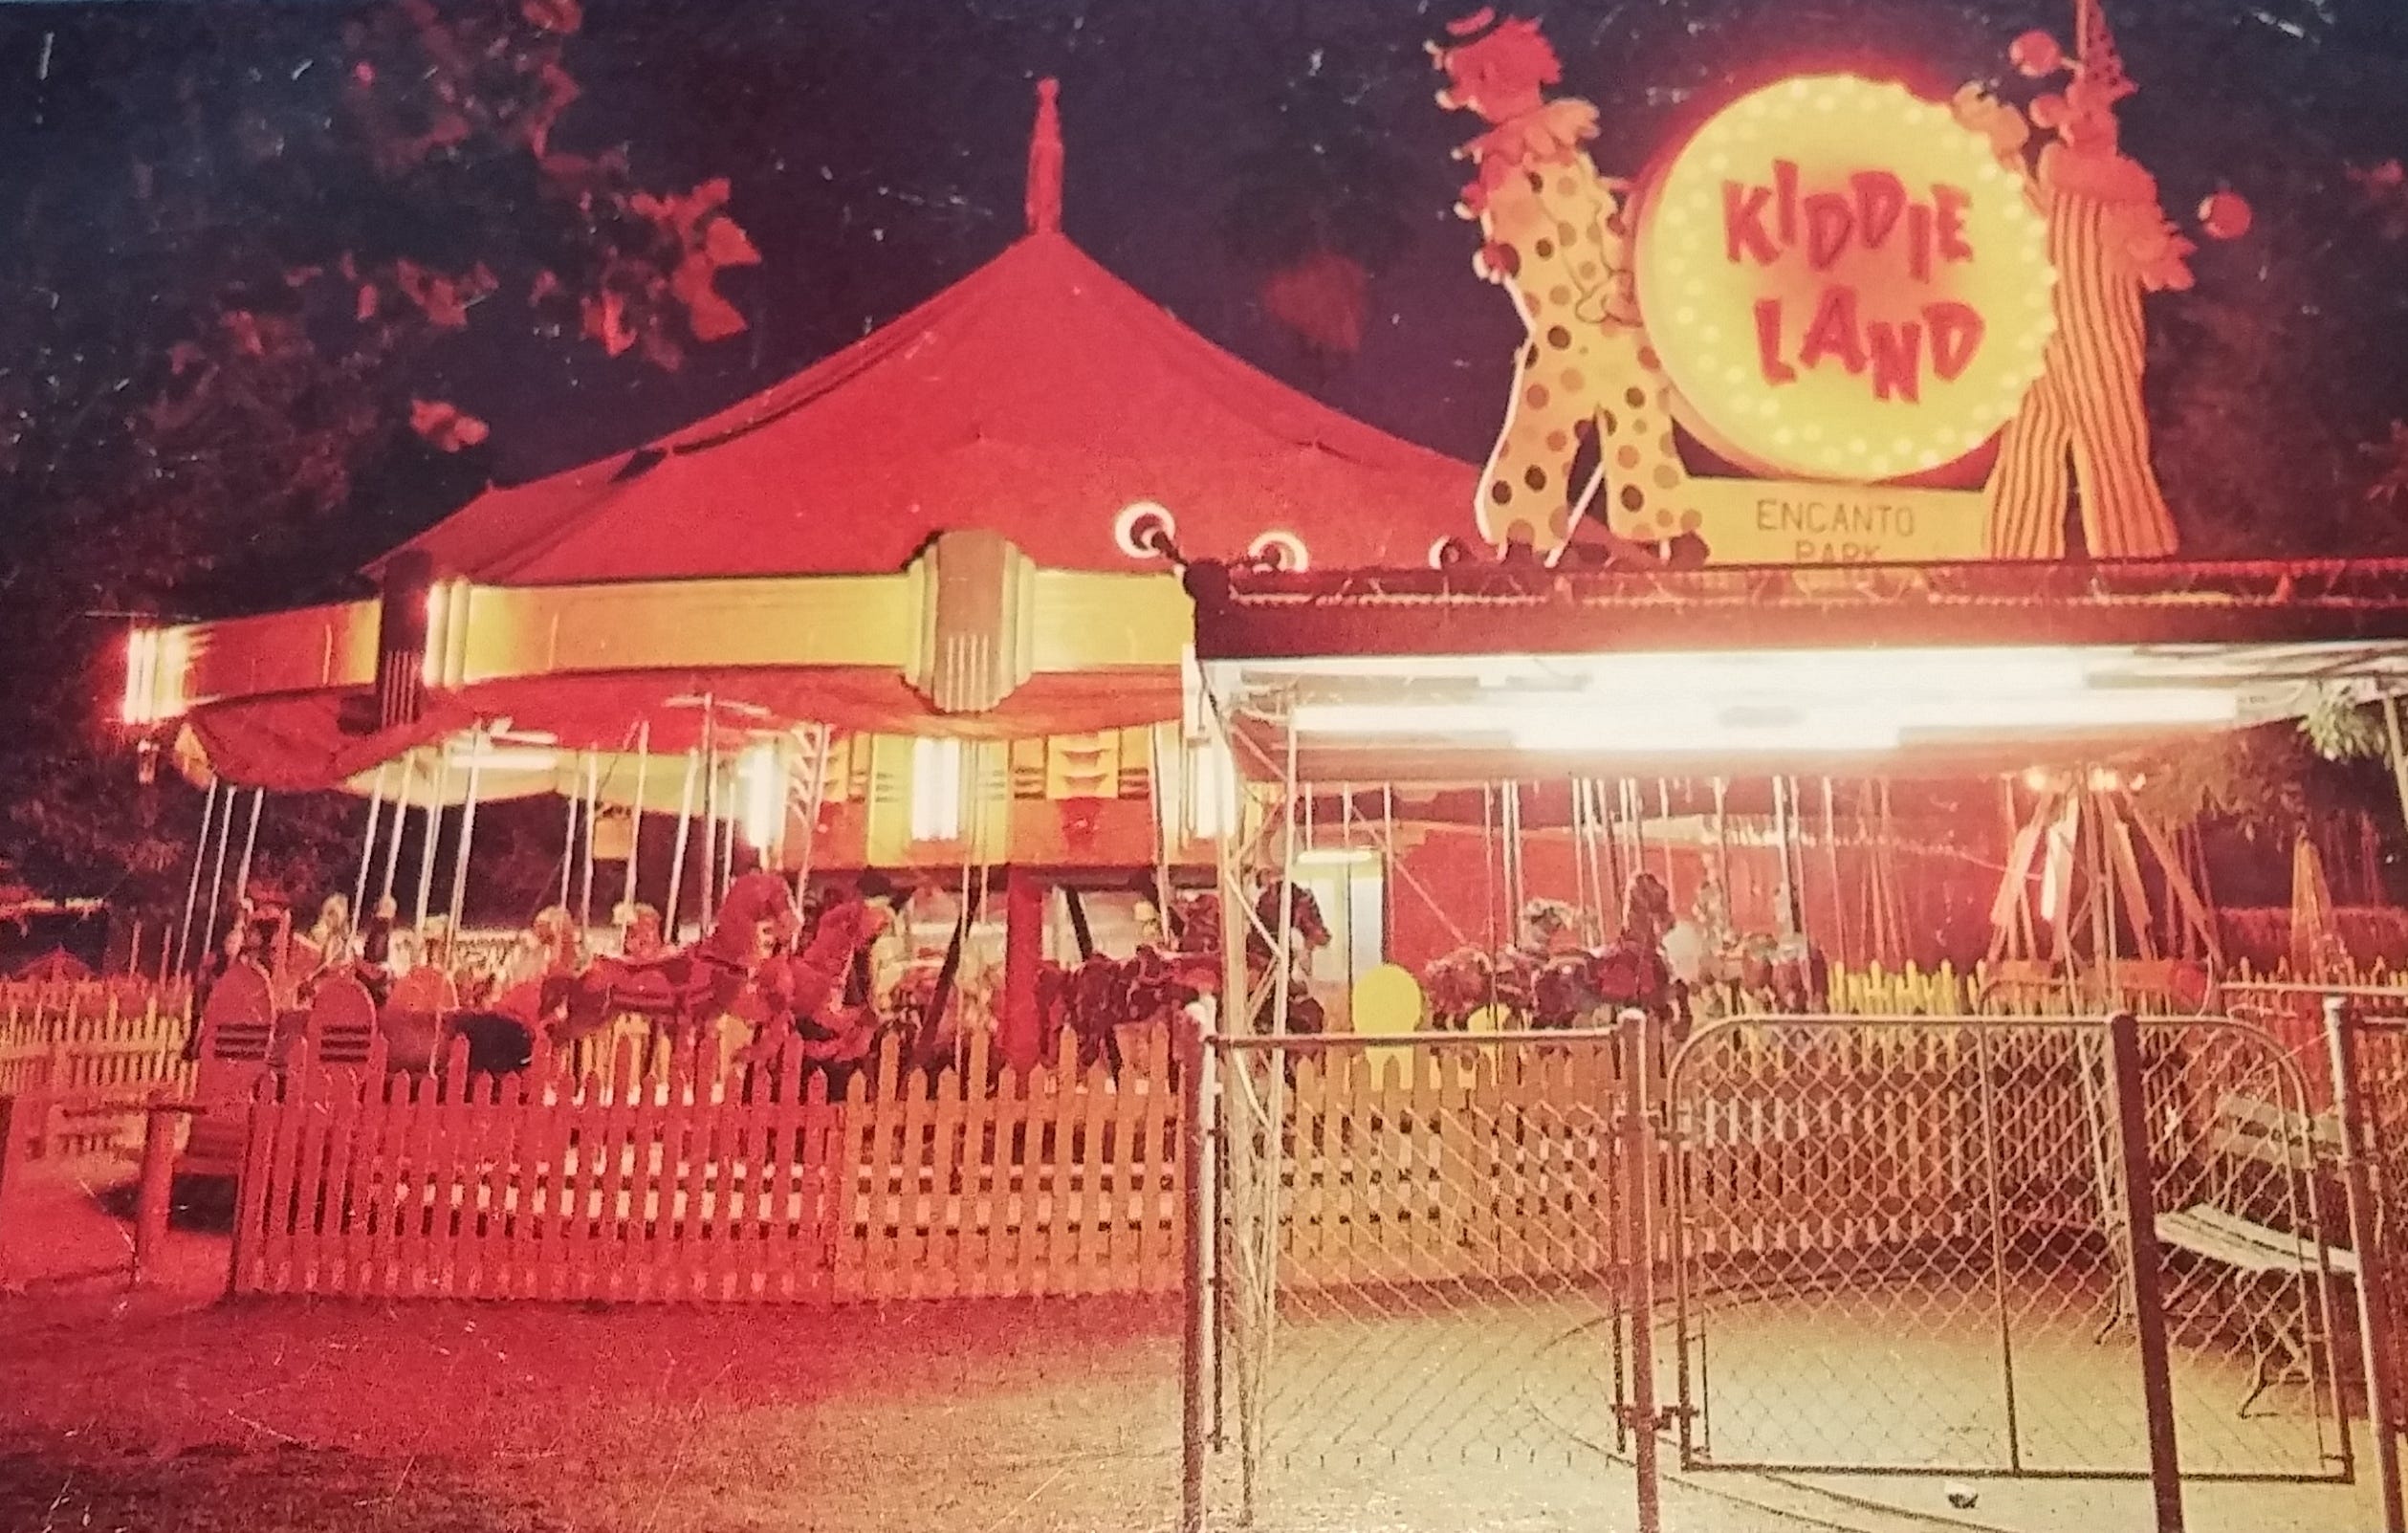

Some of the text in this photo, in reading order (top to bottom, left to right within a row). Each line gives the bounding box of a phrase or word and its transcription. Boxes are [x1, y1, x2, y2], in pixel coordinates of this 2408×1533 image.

[1722, 159, 1974, 284] KIDDIE
[1754, 286, 1985, 405] LAND
[1757, 498, 1916, 537] ENCANTO
[1794, 540, 1882, 562] PARK
